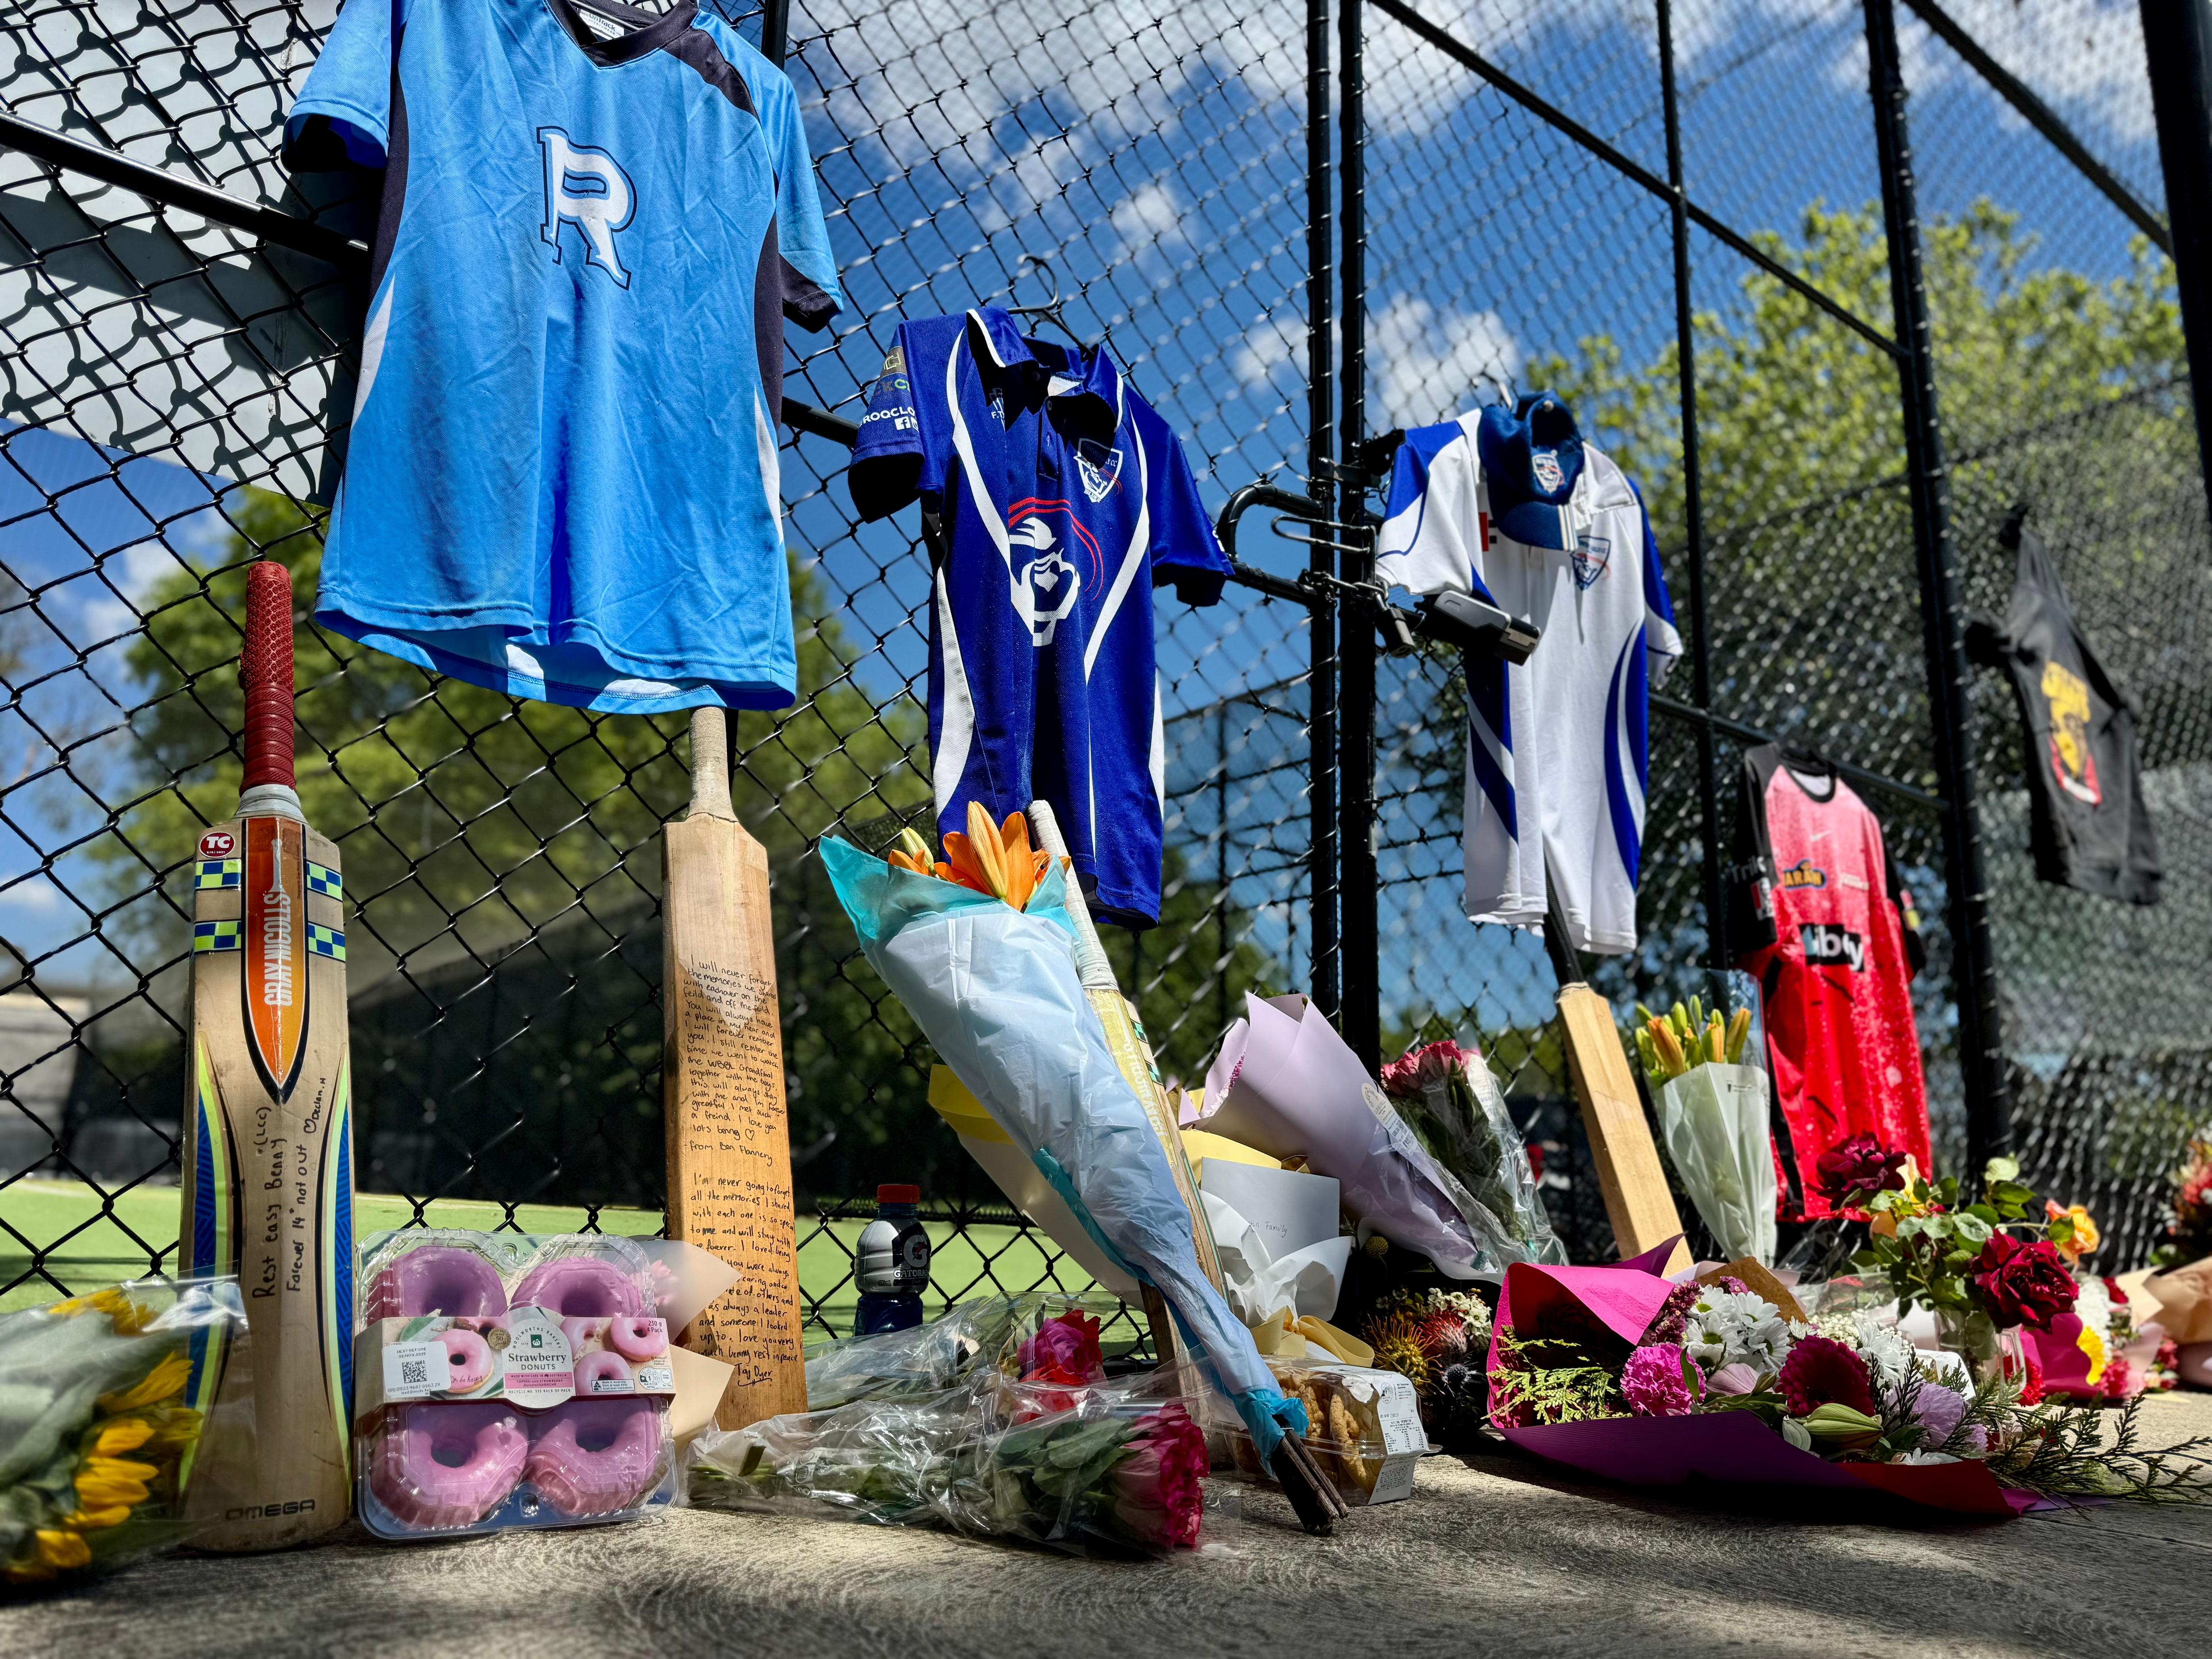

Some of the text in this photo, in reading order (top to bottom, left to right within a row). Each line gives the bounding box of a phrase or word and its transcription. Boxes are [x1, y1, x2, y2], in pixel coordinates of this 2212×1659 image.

[537, 126, 637, 290] R
[206, 836, 231, 849] TC
[264, 893, 292, 1006] GRAY NICOLLS
[687, 968, 703, 980] the
[759, 989, 776, 1000] shared
[699, 960, 772, 991] will never forget
[683, 987, 704, 999] feild
[707, 995, 723, 1004] and
[726, 999, 737, 1010] off
[740, 1002, 752, 1011] the
[684, 979, 703, 989] with
[755, 995, 767, 1004] the
[686, 999, 773, 1028] You will always have
[695, 1010, 715, 1022] place
[730, 1022, 741, 1032] my
[761, 1030, 776, 1039] and
[694, 1023, 709, 1032] will
[716, 1025, 745, 1039] forever
[687, 1045, 707, 1055] time
[760, 1058, 779, 1069] watch
[687, 1056, 703, 1065] the
[720, 1040, 736, 1048] still
[768, 1051, 778, 1059] the
[689, 1068, 721, 1080] together
[713, 1081, 728, 1090] will
[734, 1083, 760, 1096] always
[764, 1092, 778, 1106] stay
[749, 1116, 762, 1128] love
[765, 1123, 776, 1134] you
[757, 1109, 771, 1119] such
[693, 1124, 711, 1133] lots
[296, 1144, 307, 1176] out
[690, 1140, 772, 1167] from Ben Flannery
[295, 1182, 307, 1205] not
[694, 1172, 791, 1200] I'm never going to forget
[691, 1189, 791, 1212] all the memories shared
[252, 1138, 287, 1298] Rest easy Benny
[692, 1206, 711, 1217] with
[717, 1208, 735, 1218] each
[758, 1213, 767, 1222] is
[690, 1224, 791, 1249] to and will stay with
[1264, 1221, 1288, 1238] Family
[752, 1240, 791, 1262] loved being
[903, 1234, 928, 1268] G
[768, 1263, 789, 1279] always
[742, 1276, 780, 1290] caring and
[723, 1298, 749, 1317] always
[762, 1302, 788, 1317] leader
[757, 1288, 779, 1304] others
[781, 1294, 793, 1306] and
[699, 1314, 788, 1331] and someone looked
[513, 1327, 544, 1349] WOOLWORTHS
[546, 1330, 561, 1349] BAKERY
[700, 1328, 795, 1350] up love you very
[508, 1352, 566, 1363] Strawberry
[753, 1349, 771, 1360] rest
[773, 1351, 779, 1361] in
[780, 1354, 798, 1364] peace
[734, 1363, 773, 1381] Taj Dyer
[225, 1498, 316, 1521] OMEGA
